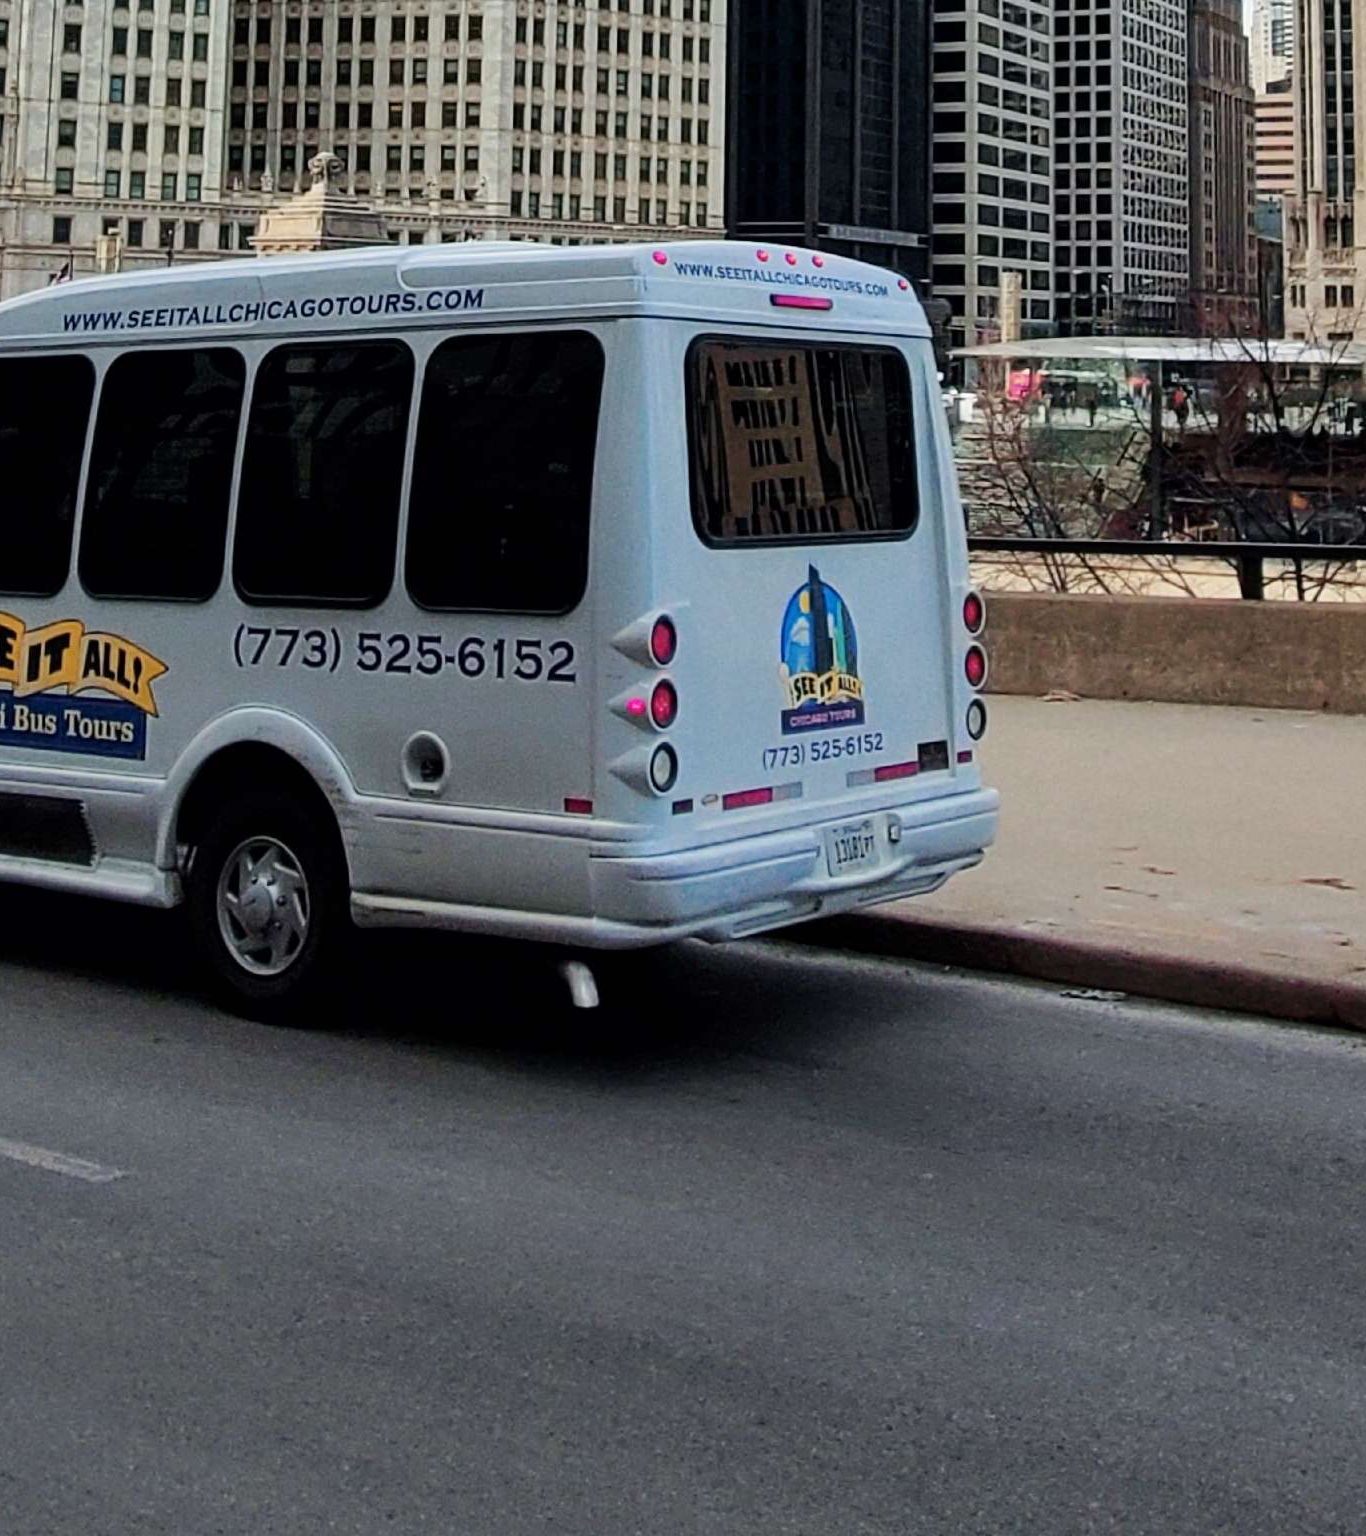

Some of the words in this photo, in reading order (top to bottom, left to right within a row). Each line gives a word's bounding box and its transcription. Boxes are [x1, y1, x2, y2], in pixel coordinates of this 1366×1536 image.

[63, 289, 485, 332] WWW.SEEITALLCHICAGOTOURS.COM
[26, 632, 71, 683] IT
[82, 638, 143, 695] ALL!
[233, 623, 342, 673] (773)
[356, 632, 577, 684] 525-6152
[793, 676, 816, 702] SEE
[820, 675, 834, 698] IT
[12, 704, 57, 735] Bus
[64, 709, 134, 743] Tours
[763, 744, 805, 770] (773)
[811, 732, 883, 761] 525-6152
